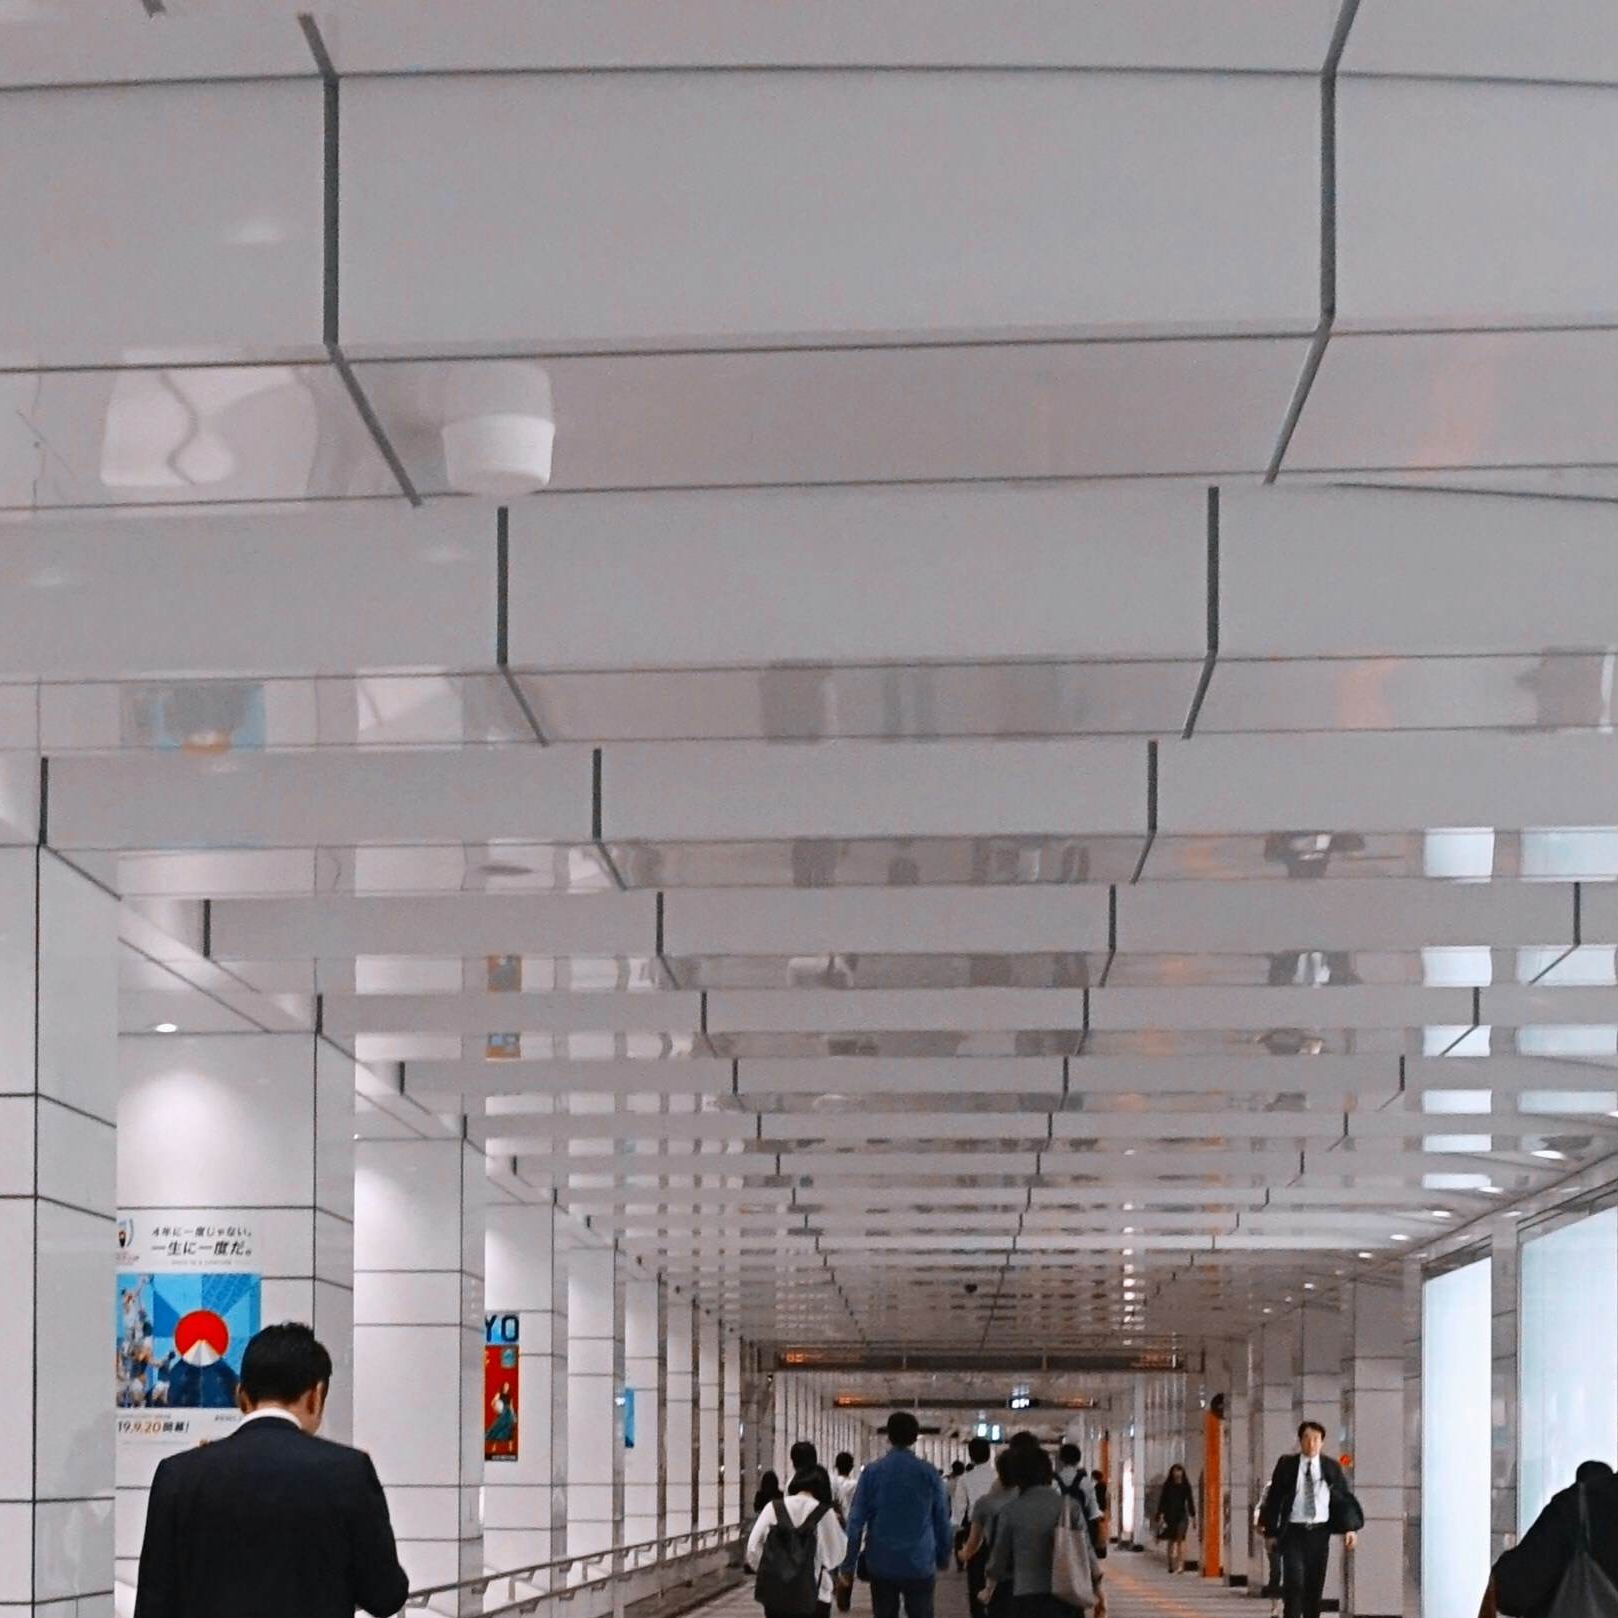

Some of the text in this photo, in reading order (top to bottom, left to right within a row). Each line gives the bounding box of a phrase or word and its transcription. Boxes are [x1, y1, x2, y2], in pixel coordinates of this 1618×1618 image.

[151, 1240, 252, 1257] 一生に一度だ。
